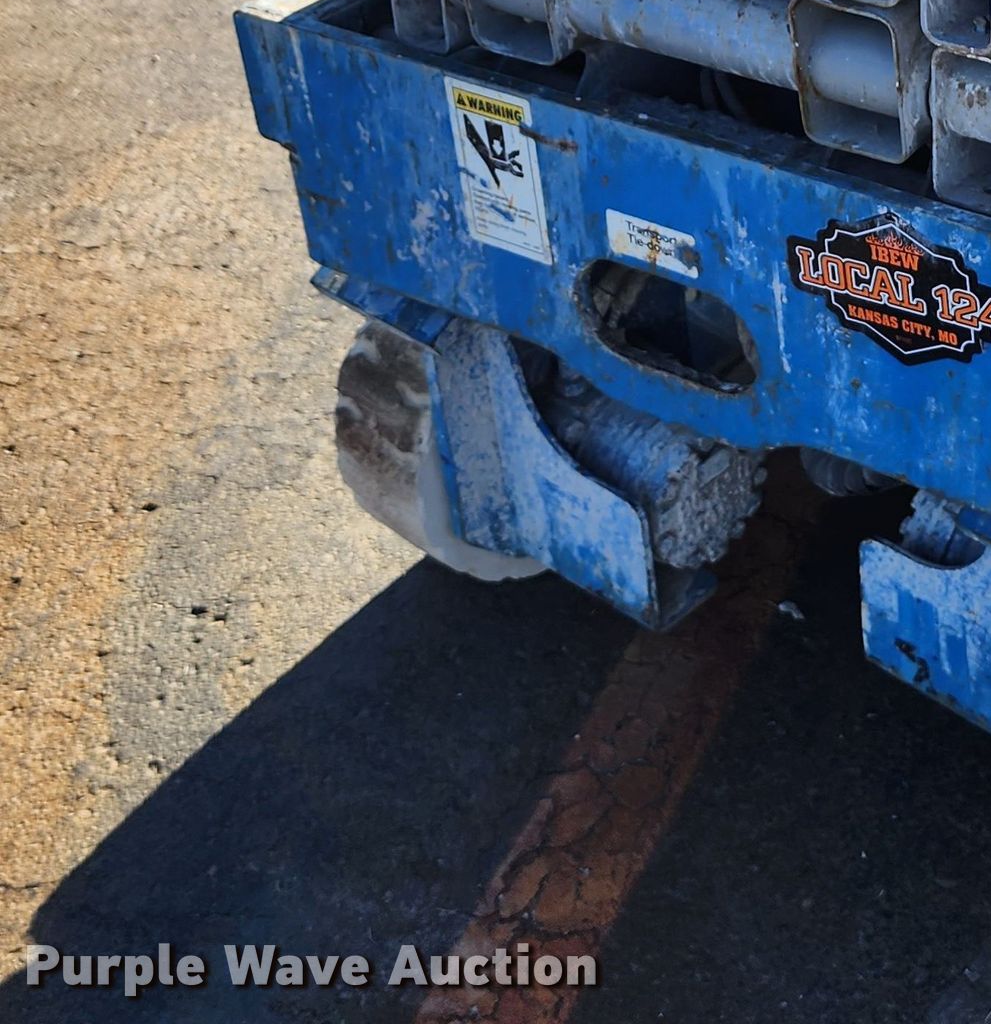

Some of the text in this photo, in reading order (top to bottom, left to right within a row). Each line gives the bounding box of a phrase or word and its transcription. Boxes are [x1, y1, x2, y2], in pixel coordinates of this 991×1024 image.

[467, 95, 522, 122] WARNING
[869, 243, 920, 272] IBEW
[795, 246, 928, 316] LOCAL
[848, 304, 899, 329] KANSAS
[902, 319, 935, 340] CITY,
[937, 329, 958, 346] MO
